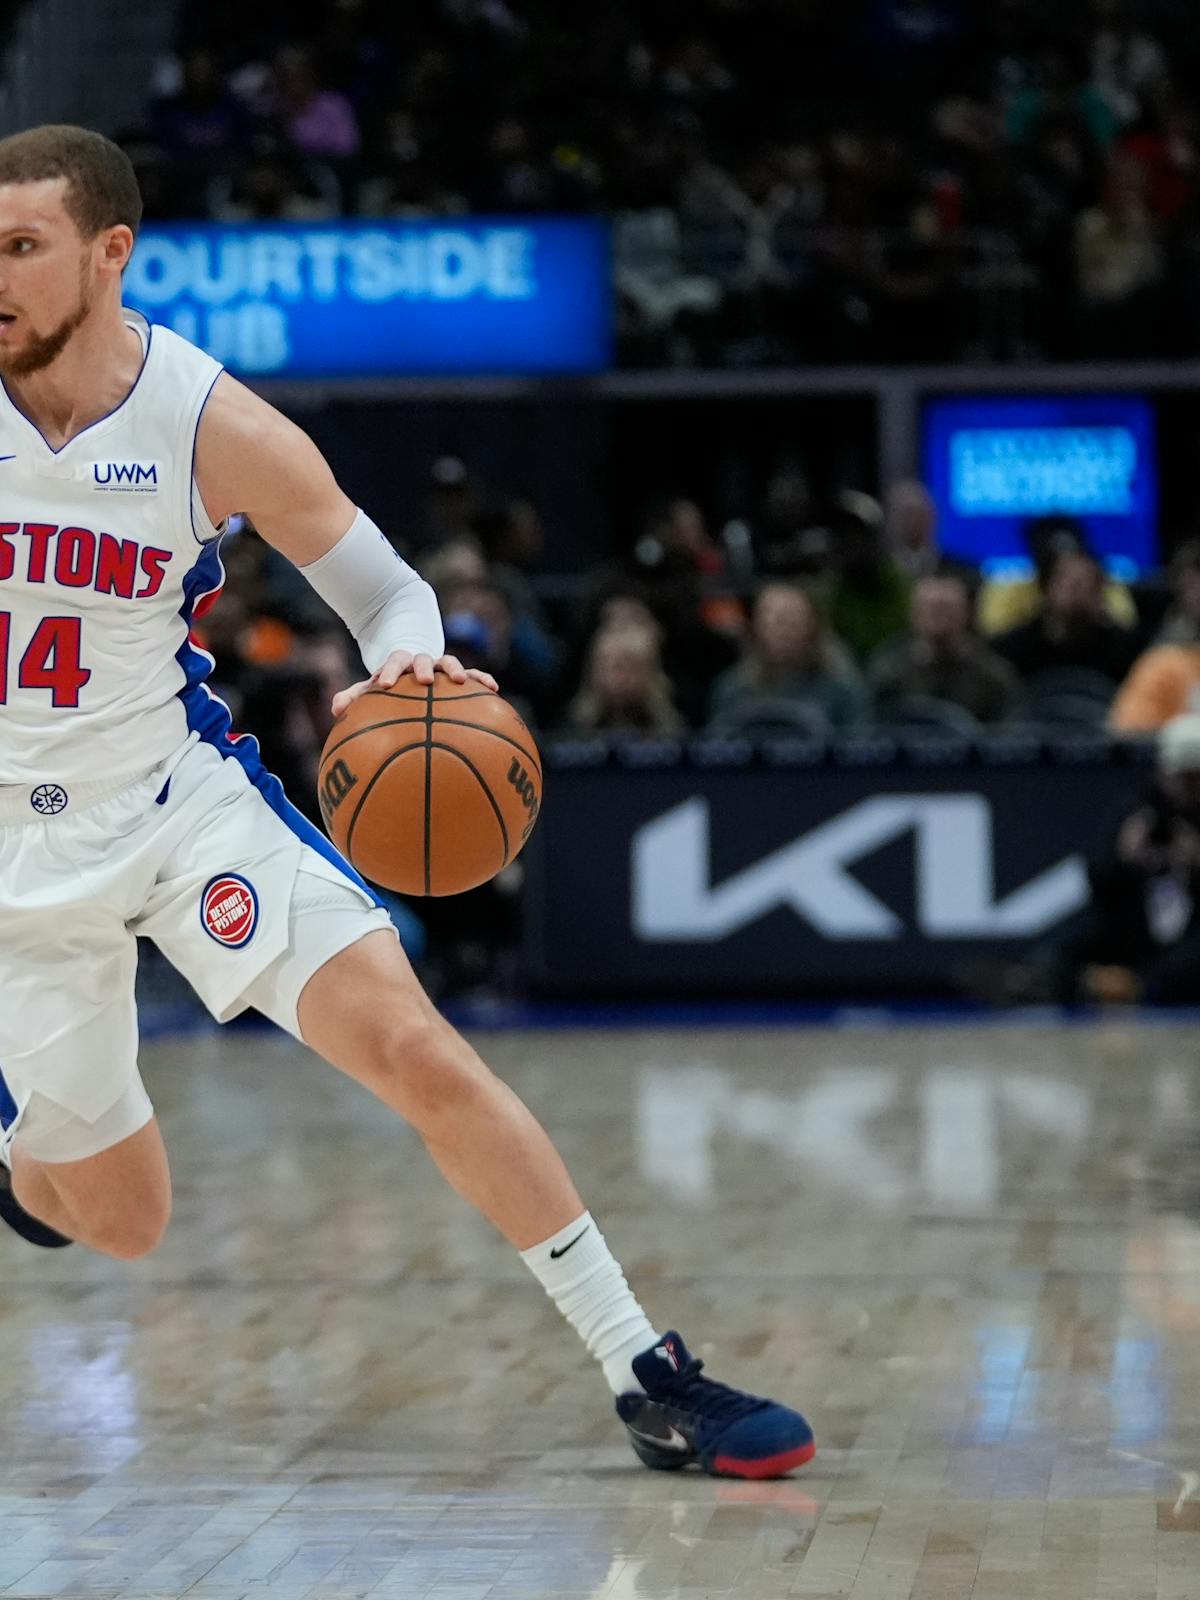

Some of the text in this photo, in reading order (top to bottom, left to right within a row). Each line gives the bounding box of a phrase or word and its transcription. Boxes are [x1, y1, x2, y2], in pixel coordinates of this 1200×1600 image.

[123, 228, 537, 302] OURTSIDE
[94, 463, 158, 484] UWM
[209, 890, 243, 921] DETROIT
[213, 901, 248, 932] PISTONS
